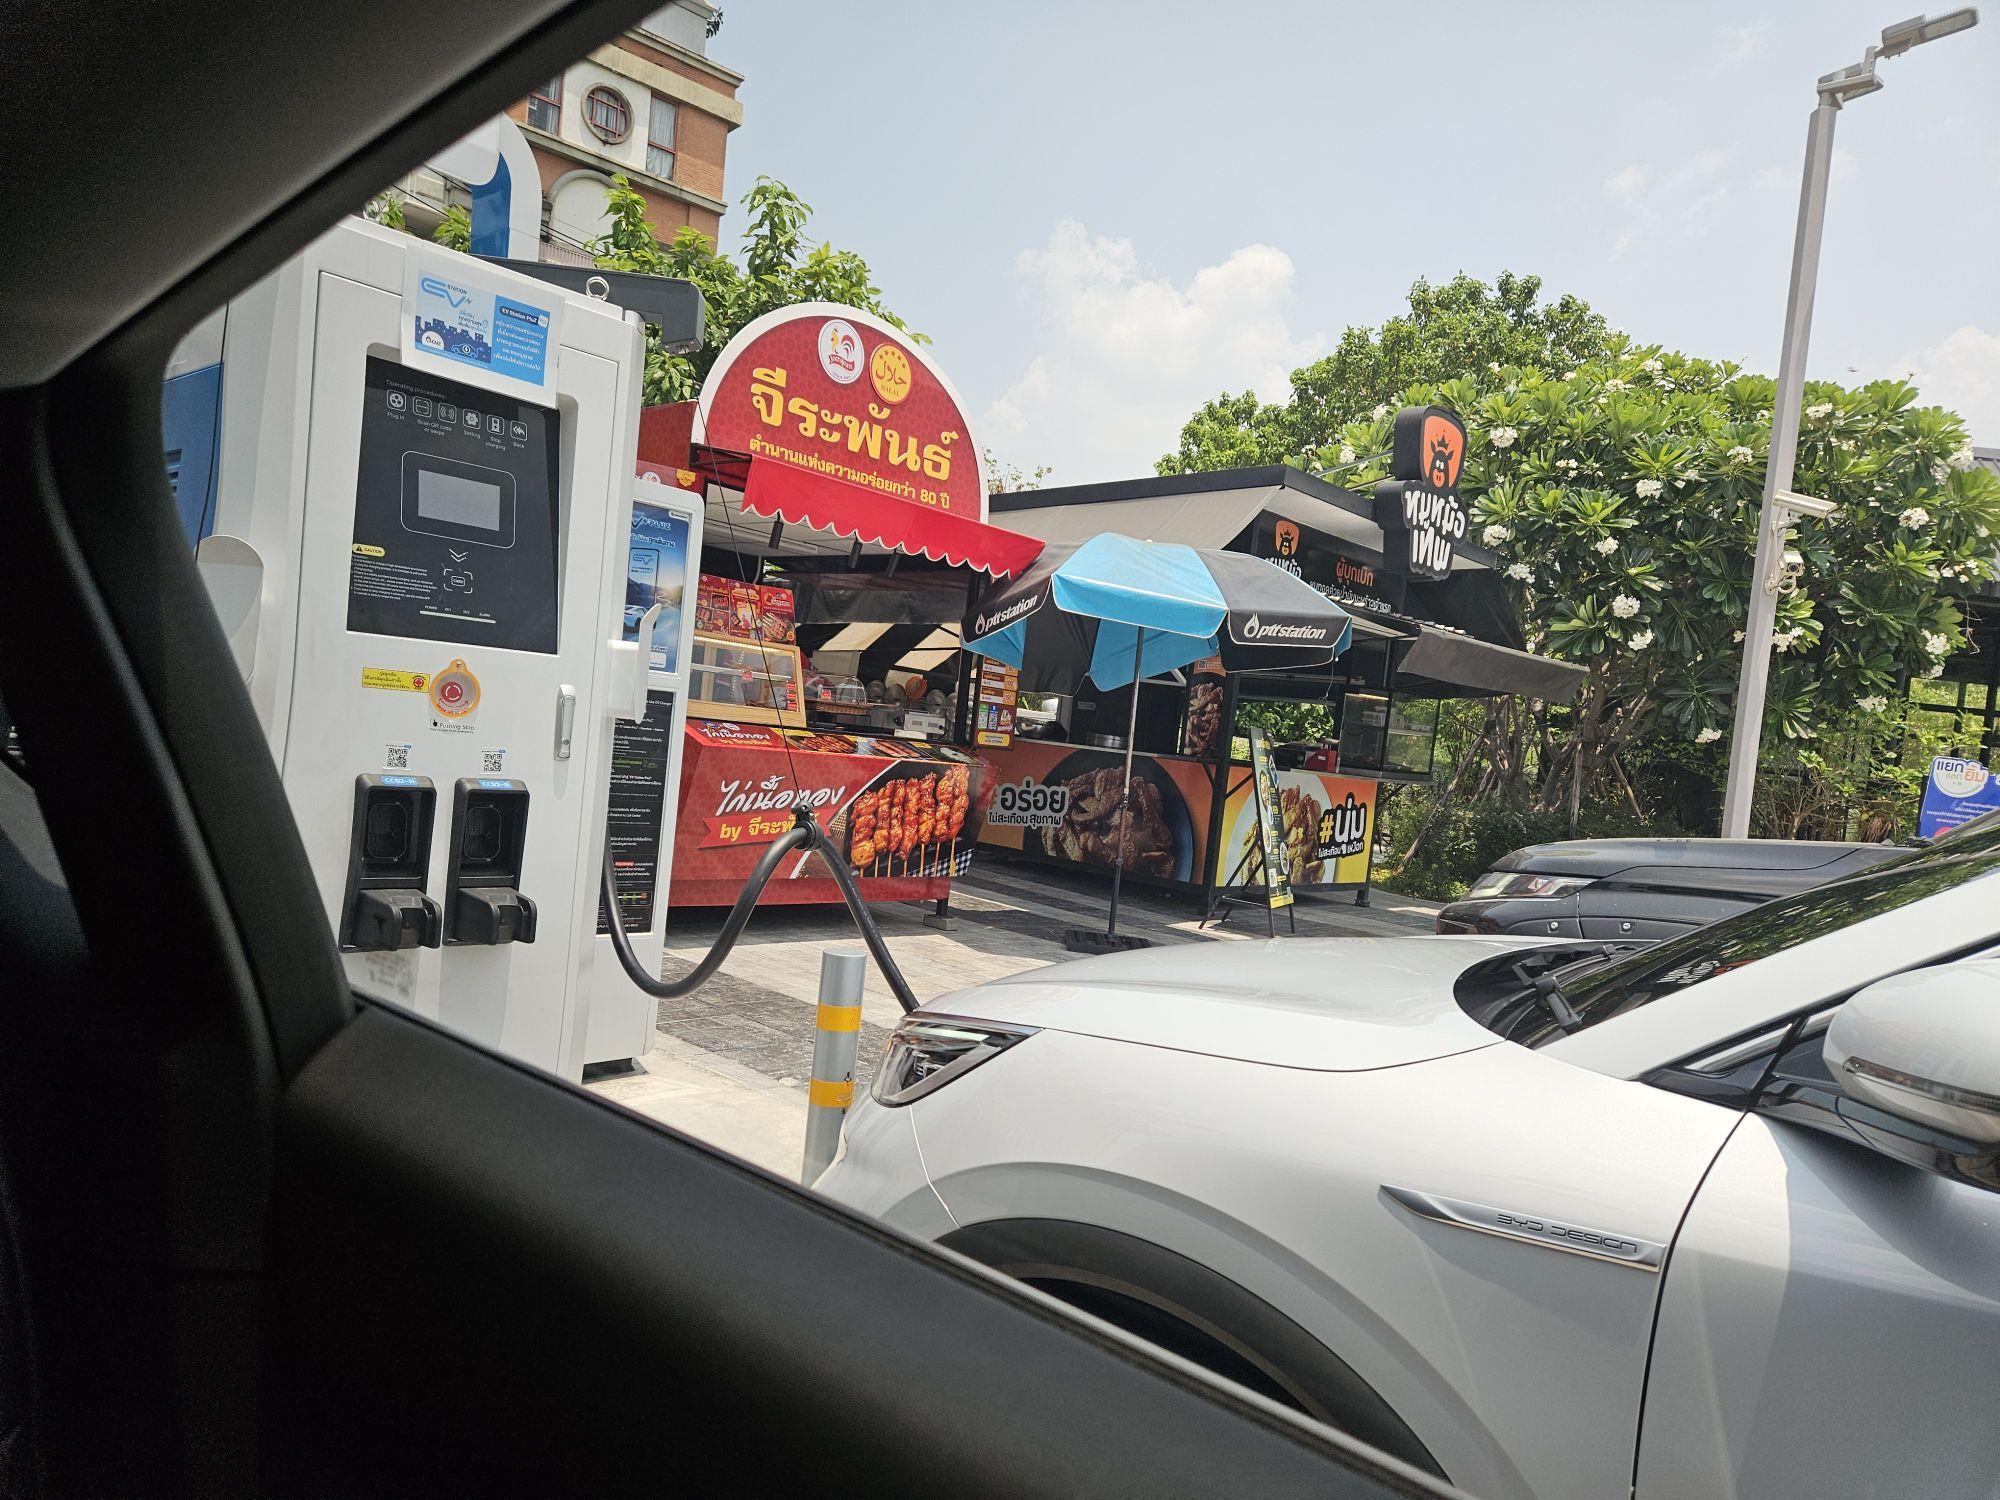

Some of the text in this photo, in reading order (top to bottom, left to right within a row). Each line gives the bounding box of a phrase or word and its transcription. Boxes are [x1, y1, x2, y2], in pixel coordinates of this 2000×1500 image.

[386, 379, 414, 392] Operating
[751, 367, 958, 481] จีระพันธ์
[749, 434, 950, 509] ตำนานแห่งความอร่อยกว่า 80 ปี
[1412, 526, 1452, 572] เทพ
[1937, 761, 1964, 773] แยก
[719, 823, 742, 840] by
[989, 812, 1061, 828] ไม่สะเทือน สุขภาพ
[1497, 1213, 1638, 1254] BYD DESIGN
